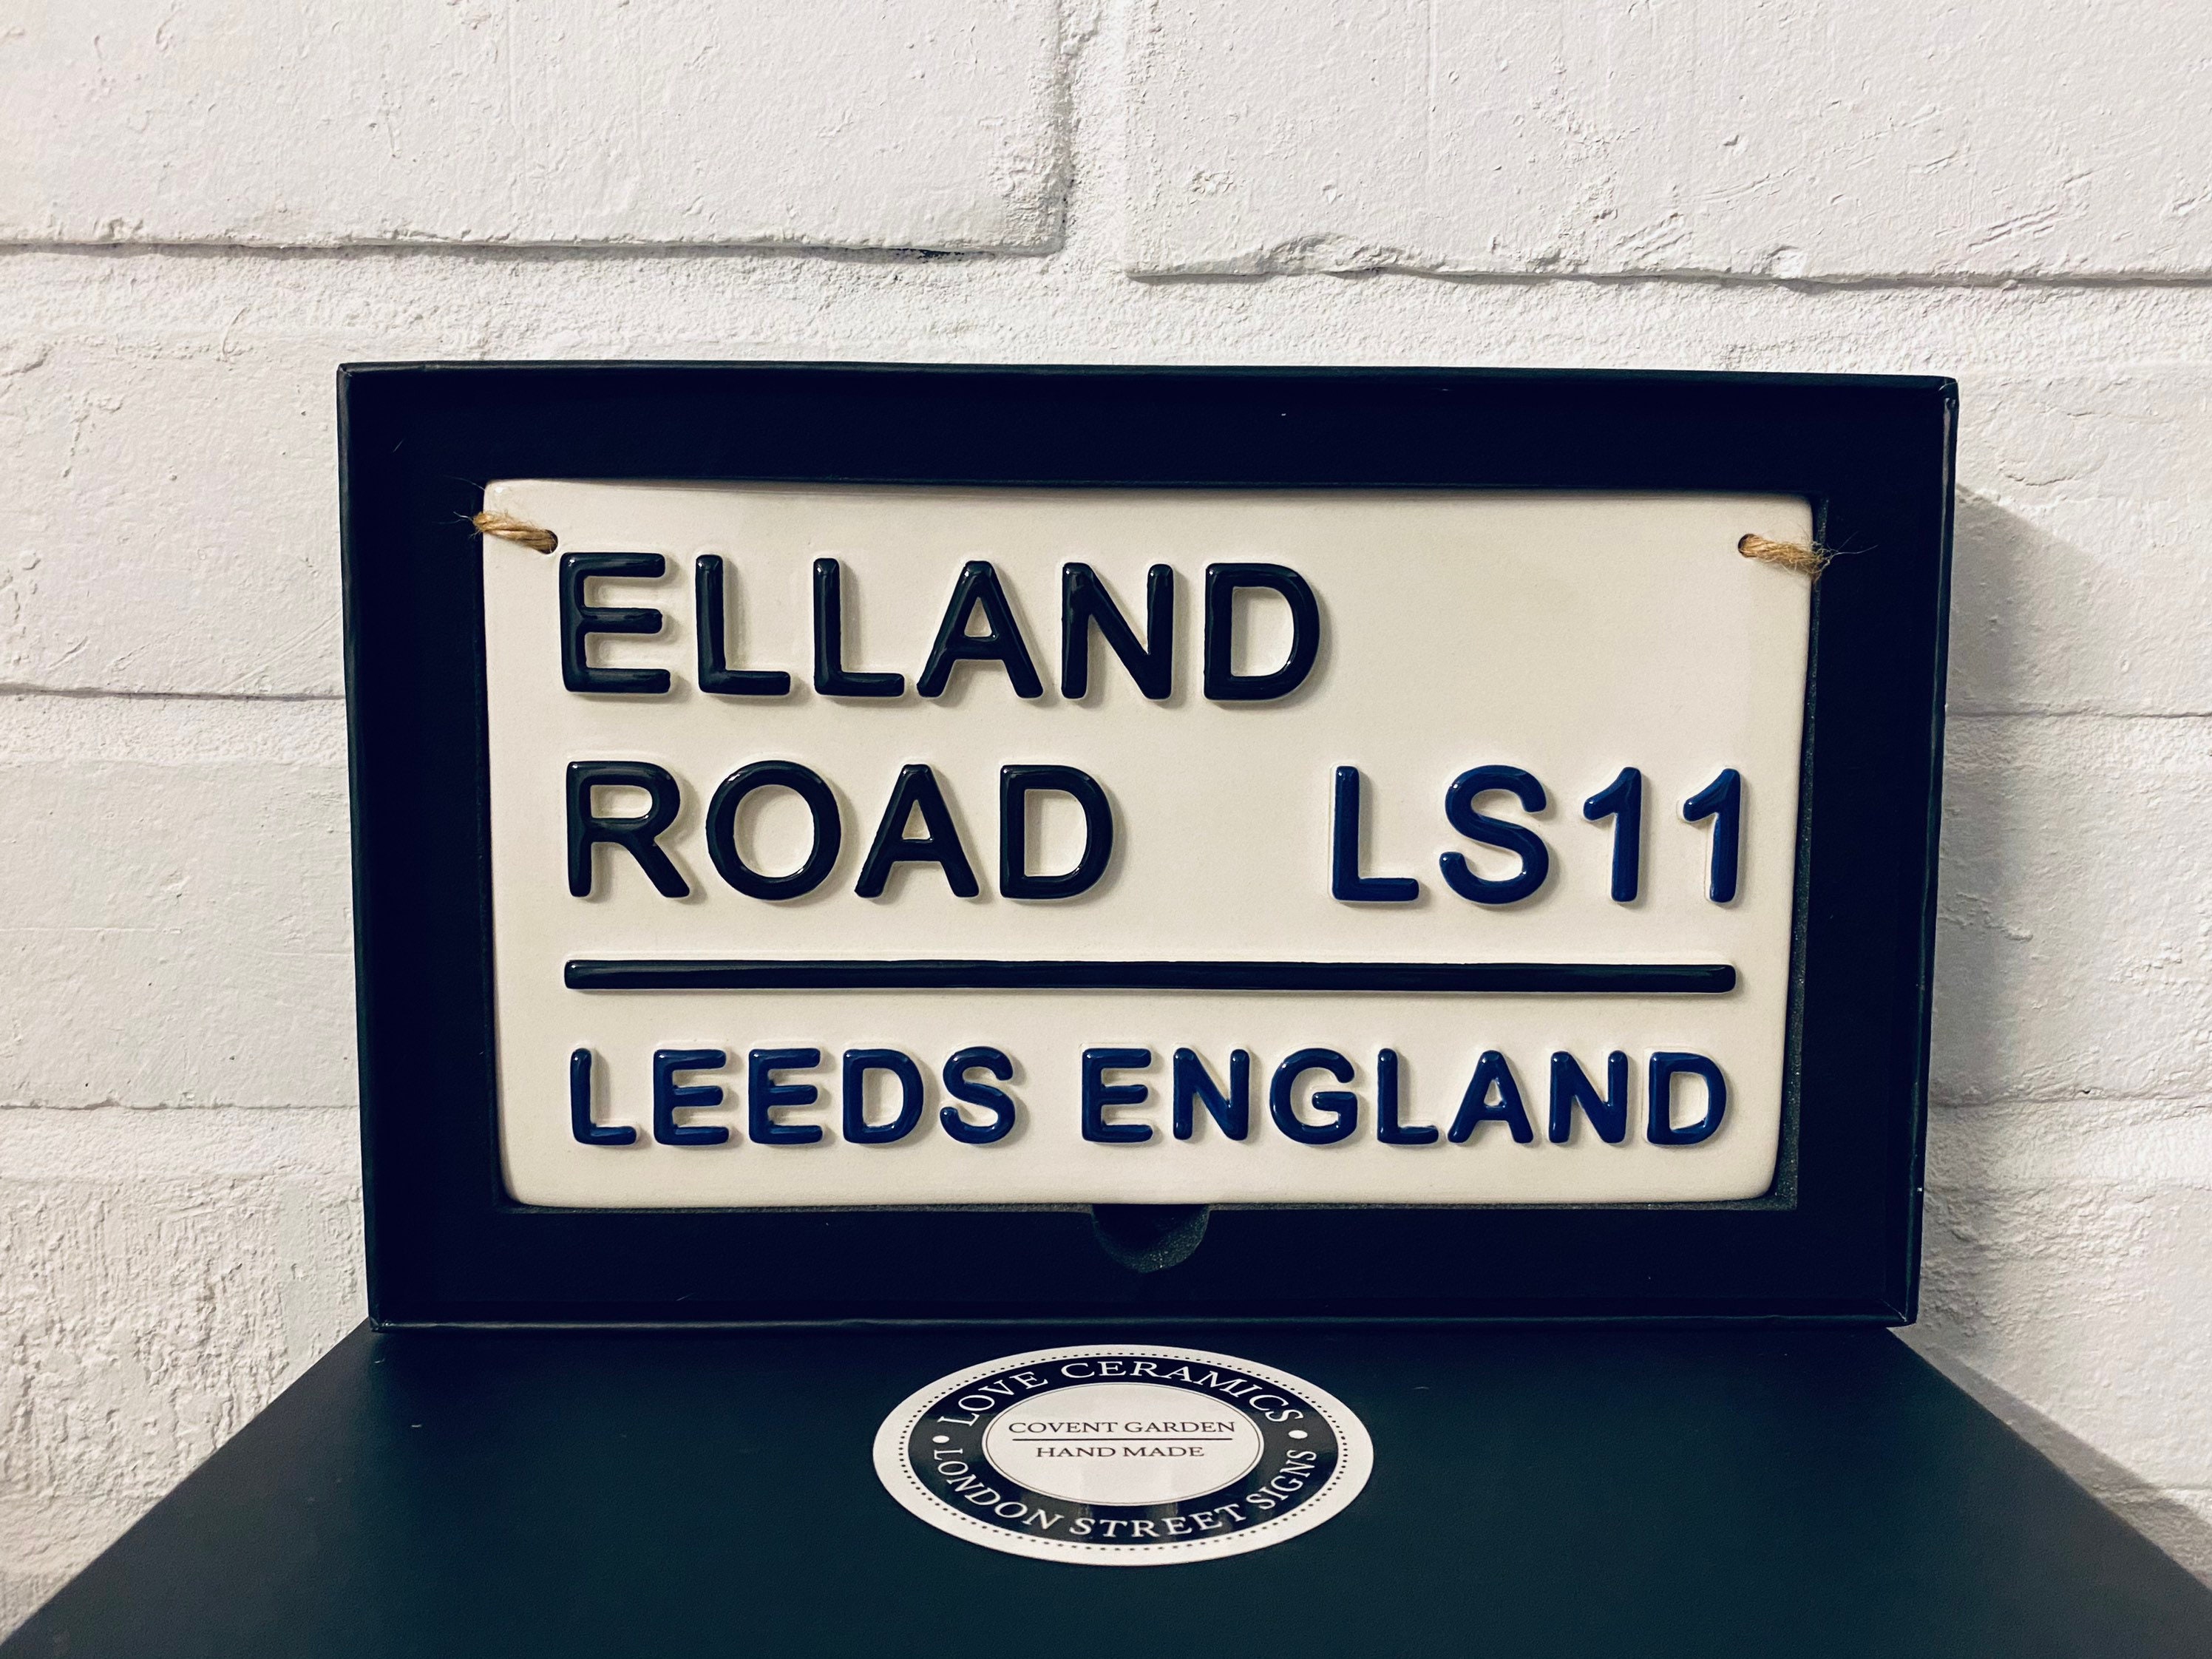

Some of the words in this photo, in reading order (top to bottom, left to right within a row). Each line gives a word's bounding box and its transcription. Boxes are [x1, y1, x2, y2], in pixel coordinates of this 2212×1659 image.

[558, 552, 1321, 702] ELLAND
[566, 760, 1114, 901] ROAD
[1331, 764, 1742, 905] LS11
[570, 1046, 1016, 1147] LEEDS
[1082, 1047, 1727, 1146] ENGLAND
[938, 1370, 1048, 1427] LOVE
[1061, 1360, 1303, 1425] CERAMICS
[1008, 1421, 1118, 1434] COVENT
[1124, 1421, 1235, 1434] GARDEN
[932, 1447, 1063, 1530] LONDON
[1068, 1503, 1246, 1538] STREET
[1246, 1448, 1317, 1510] SIGNS
[1036, 1446, 1116, 1458] HAND
[1122, 1445, 1204, 1458] MADE
